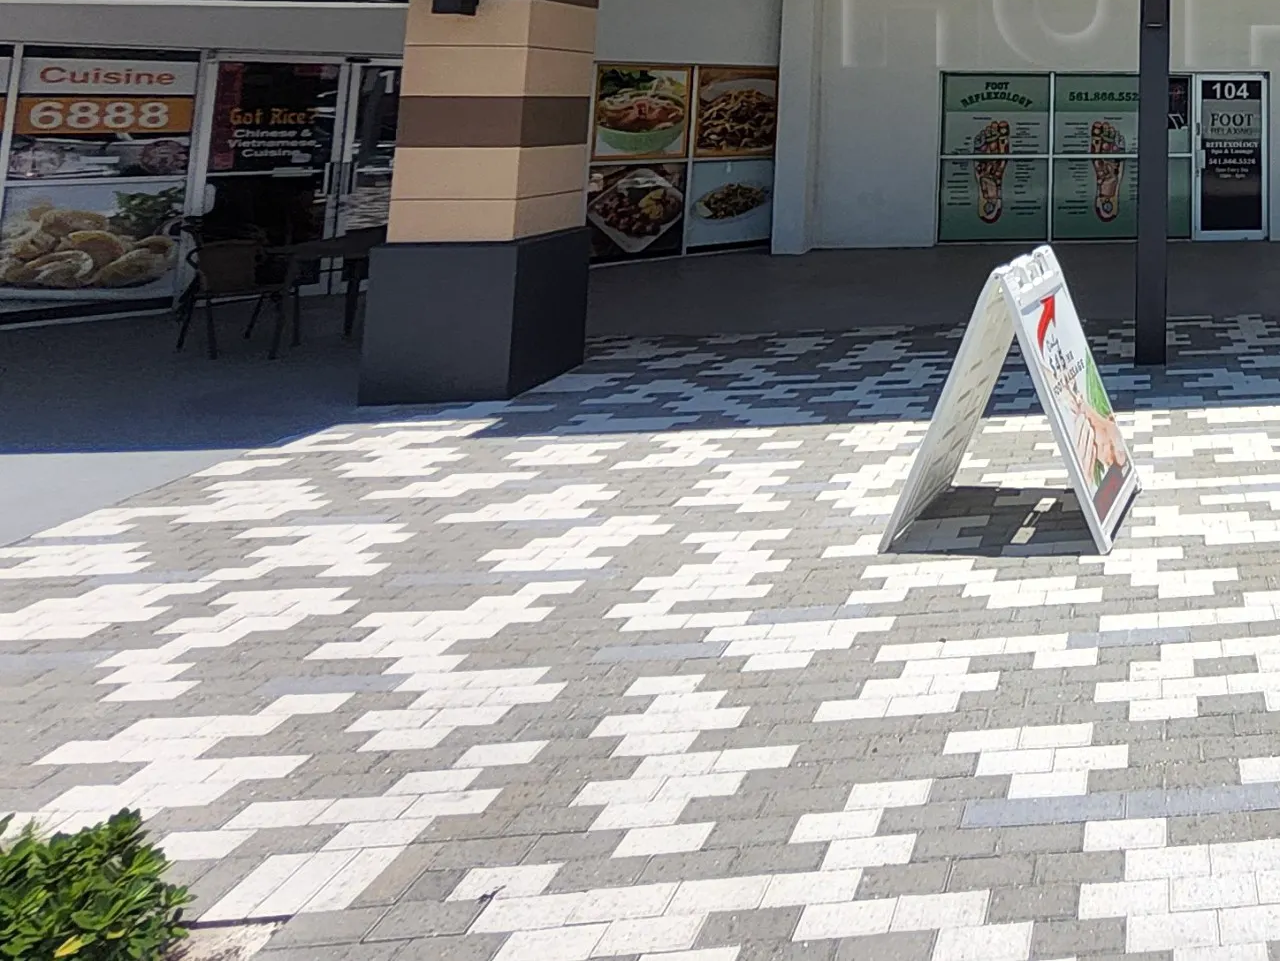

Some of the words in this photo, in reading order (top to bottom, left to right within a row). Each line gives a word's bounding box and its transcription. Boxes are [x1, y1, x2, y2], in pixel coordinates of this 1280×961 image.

[40, 66, 177, 86] Cuisine
[985, 81, 1010, 91] FOOT
[1211, 82, 1250, 99] 104
[960, 91, 1034, 108] REFLEXOLOGY
[1068, 91, 1140, 102] 561.866.552
[29, 100, 170, 130] 6888
[228, 106, 264, 126] Got
[1210, 112, 1254, 127] FOOT
[232, 128, 297, 138] Chinese
[1210, 127, 1253, 136] RELAXING
[227, 138, 317, 149] Vietnamese
